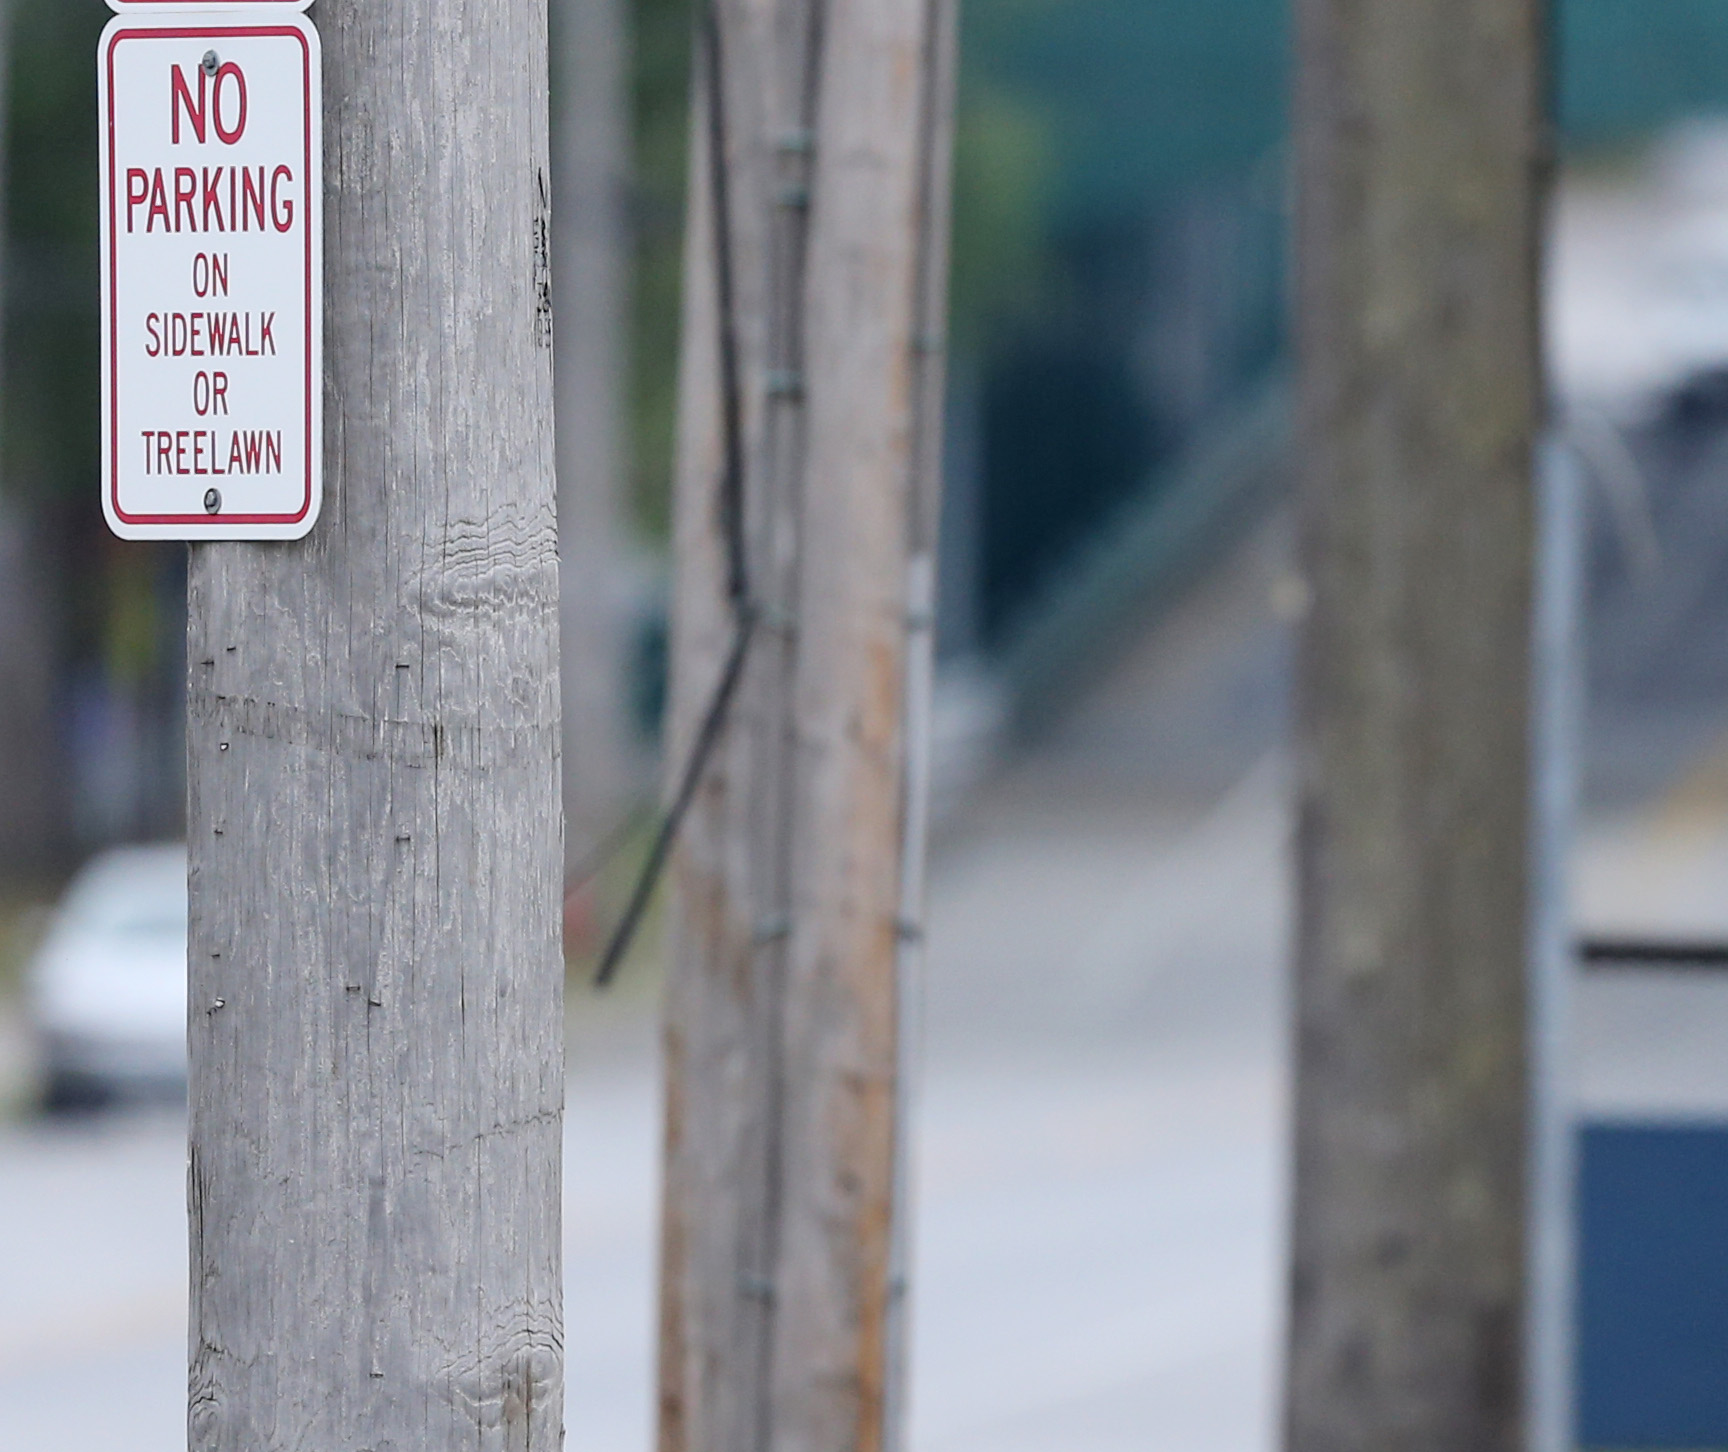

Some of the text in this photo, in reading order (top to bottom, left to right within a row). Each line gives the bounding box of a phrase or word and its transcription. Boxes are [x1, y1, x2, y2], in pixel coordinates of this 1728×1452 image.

[170, 61, 247, 145] NO
[126, 164, 294, 233] PARKING
[193, 252, 229, 298] ON
[145, 311, 276, 357] SIDEWALK
[193, 370, 229, 416] OR
[141, 430, 281, 475] TREELAWN
